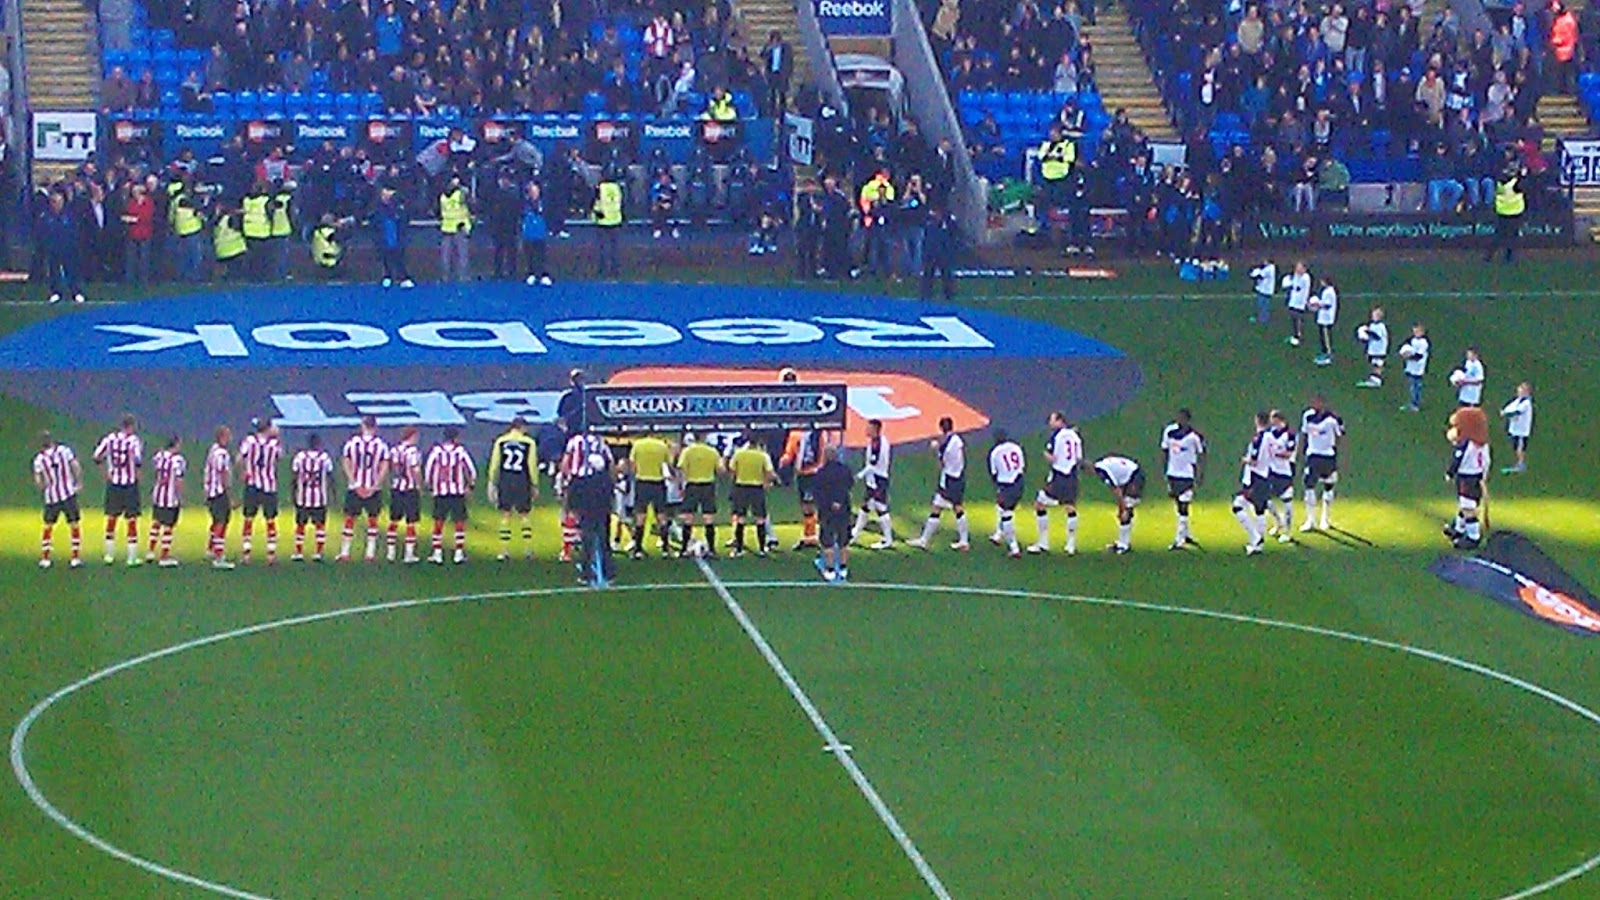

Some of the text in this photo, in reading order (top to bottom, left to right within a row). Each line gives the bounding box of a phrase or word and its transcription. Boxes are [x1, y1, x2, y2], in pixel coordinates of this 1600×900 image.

[820, 1, 884, 17] Reebok
[176, 124, 224, 138] Reebok
[299, 125, 346, 138] Reebok
[532, 125, 578, 138] Reebok
[644, 124, 690, 138] Reebok
[94, 316, 996, 356] Reebok
[608, 397, 818, 413] BARCLAYS PREMIER LEAGUE
[1065, 440, 1078, 460] 31
[503, 448, 524, 470] 22
[1002, 451, 1020, 471] 19
